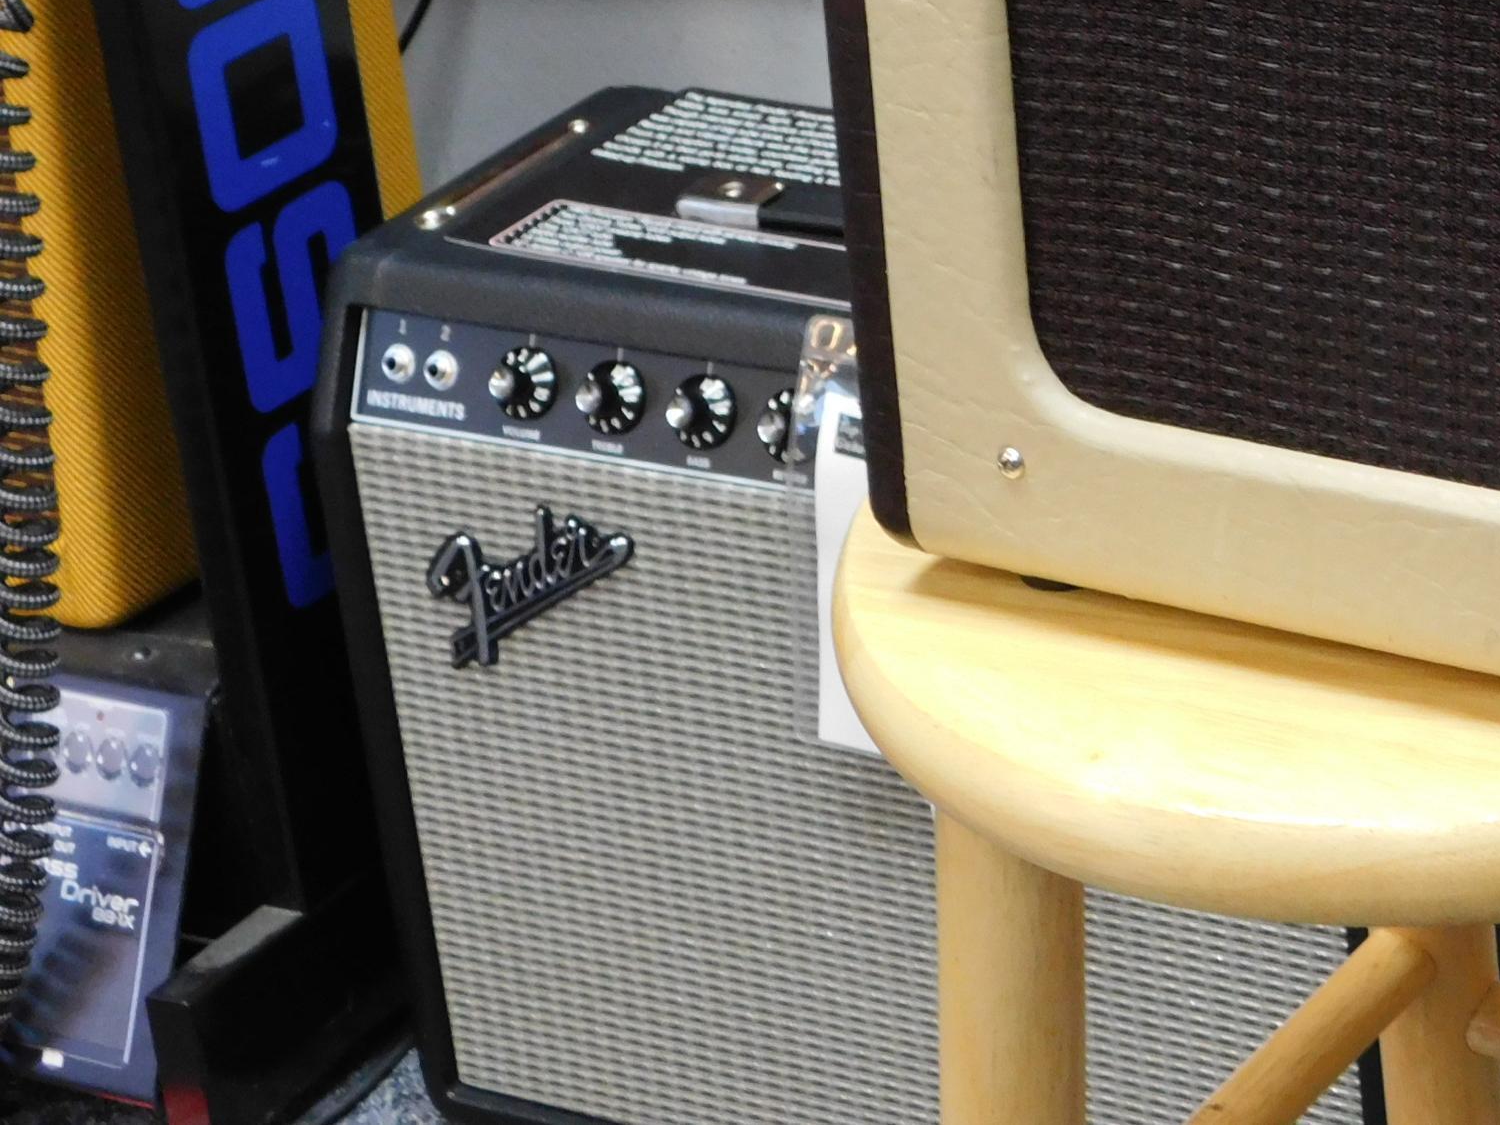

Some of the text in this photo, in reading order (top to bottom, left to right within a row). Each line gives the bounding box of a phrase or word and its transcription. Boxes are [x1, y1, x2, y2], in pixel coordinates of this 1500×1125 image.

[366, 388, 467, 421] INSTRUMENTS
[426, 505, 634, 670] Fender
[60, 878, 140, 914] Driver
